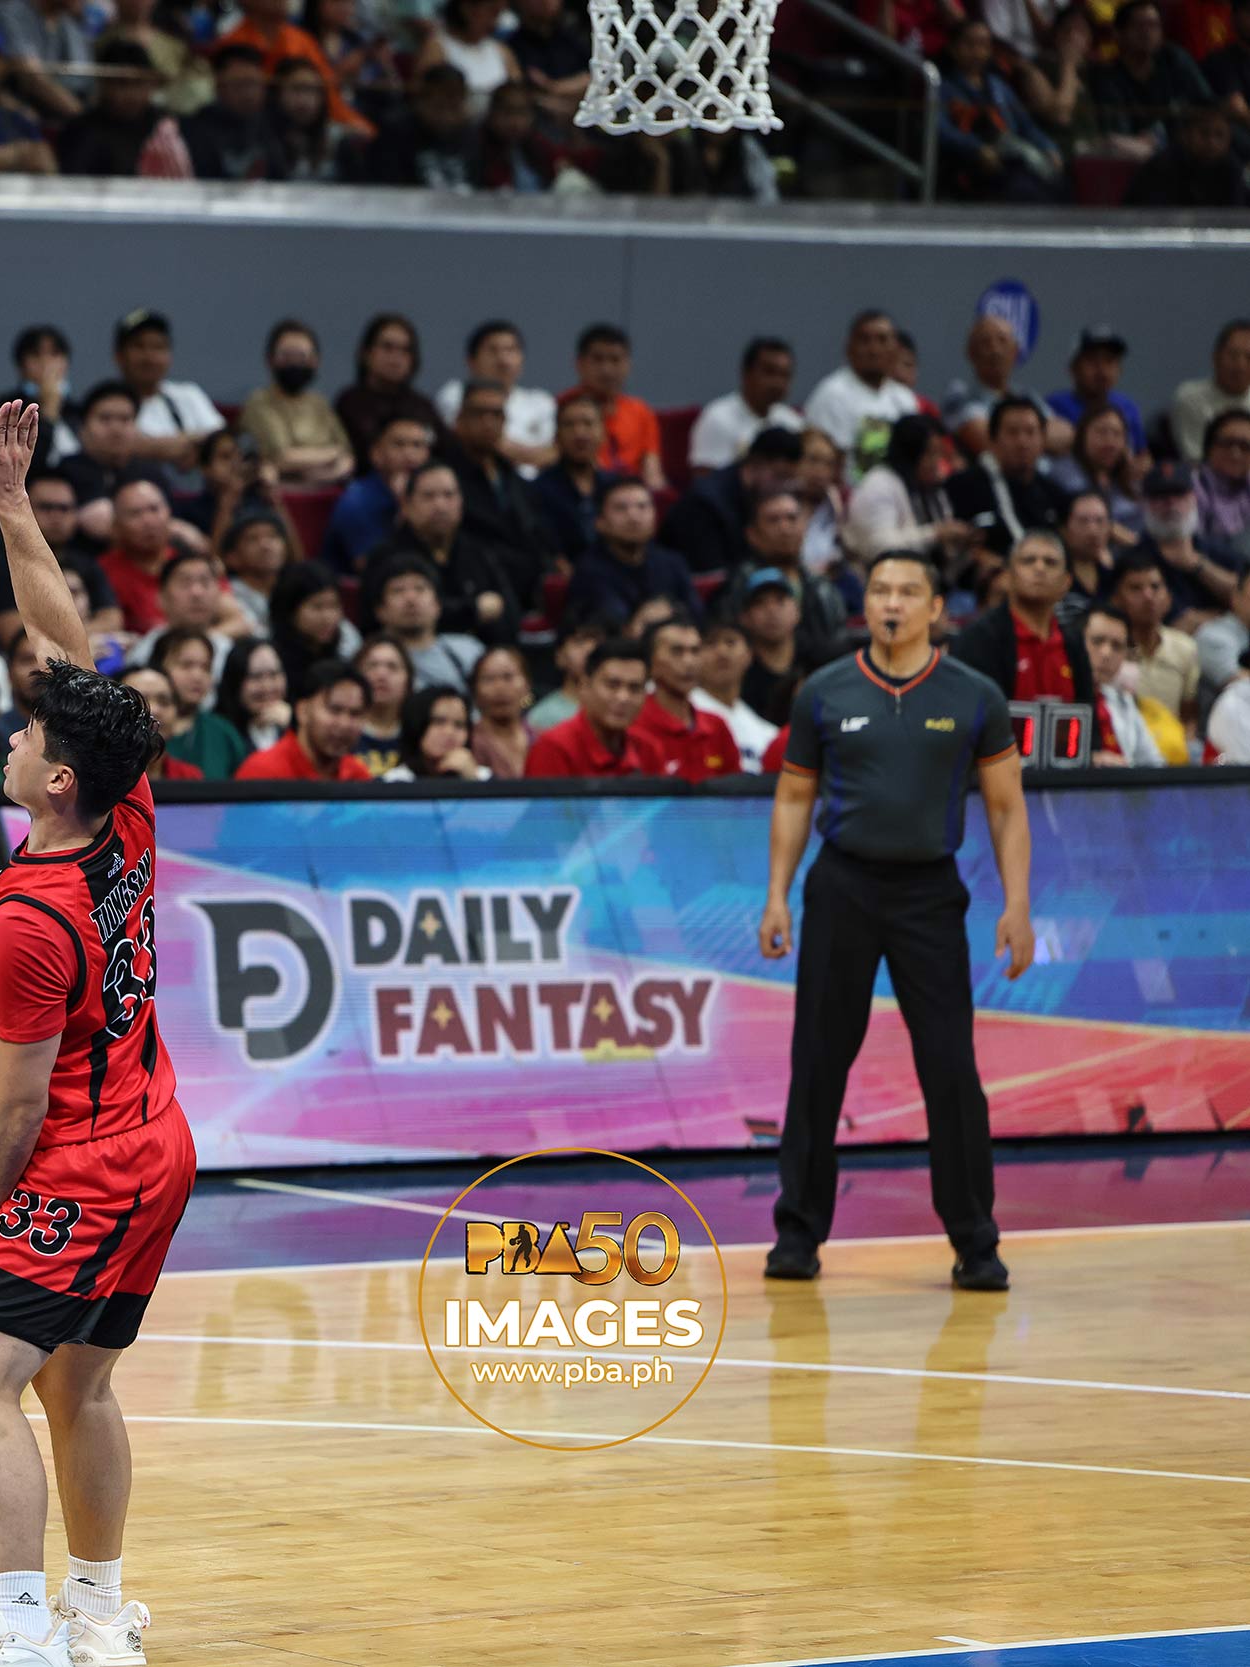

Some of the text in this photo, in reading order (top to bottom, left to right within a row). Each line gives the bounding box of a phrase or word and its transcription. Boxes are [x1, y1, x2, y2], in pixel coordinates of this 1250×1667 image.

[88, 847, 153, 945] TIONGSON
[350, 893, 574, 965] DAILY
[375, 979, 713, 1057] FANTASY
